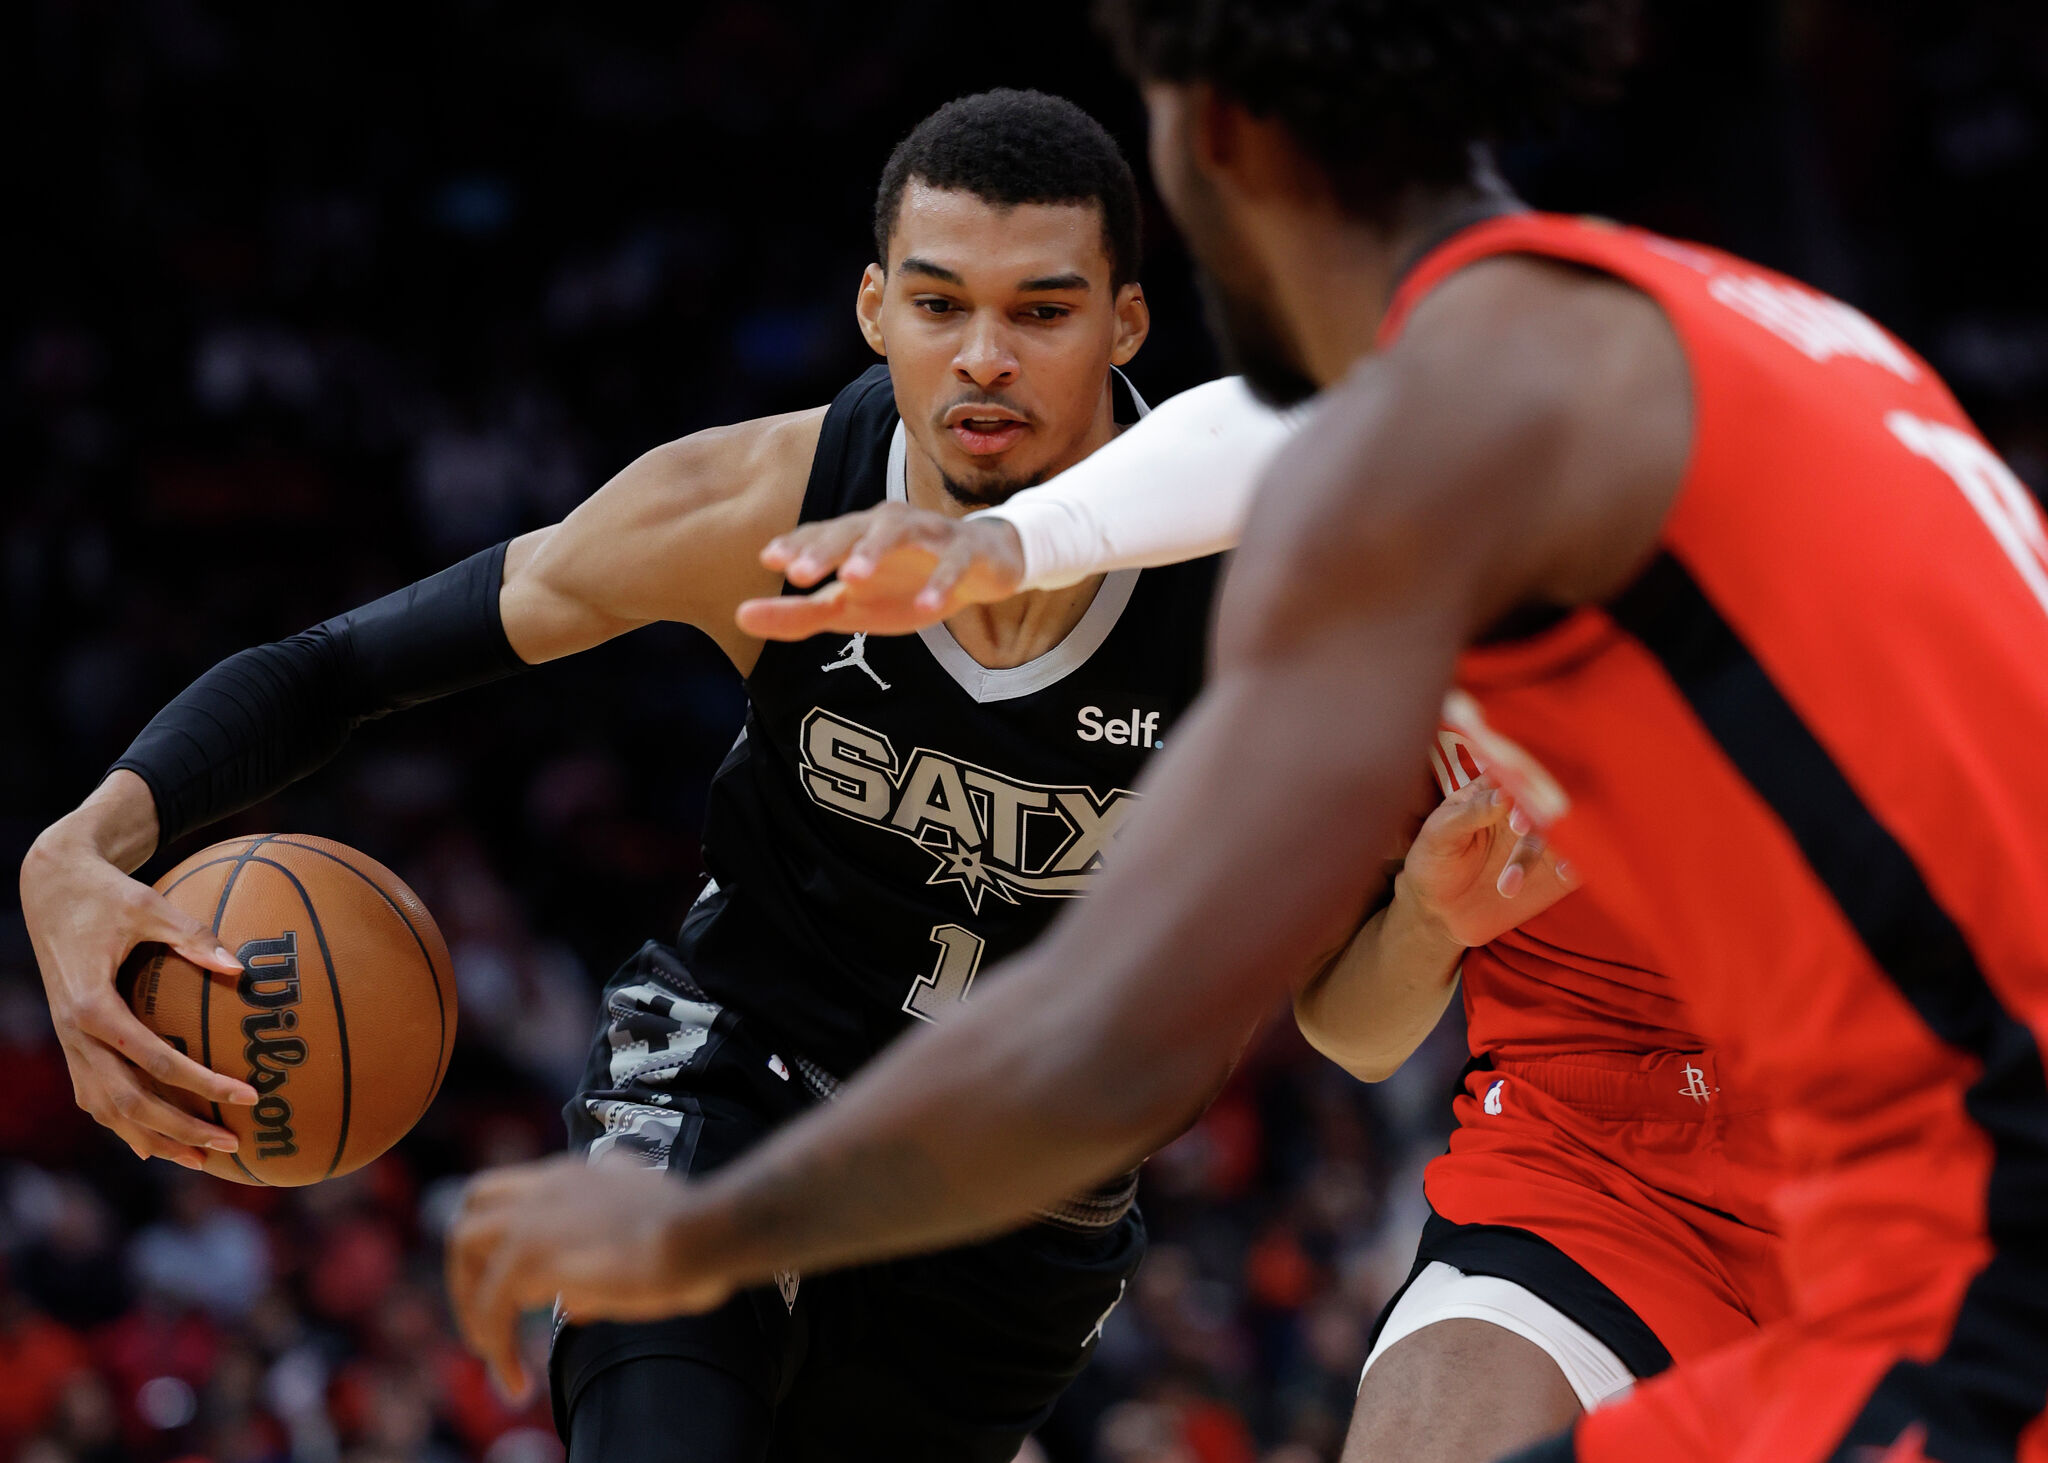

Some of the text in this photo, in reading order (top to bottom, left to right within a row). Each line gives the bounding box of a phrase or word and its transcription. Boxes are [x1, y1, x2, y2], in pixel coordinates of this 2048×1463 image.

[800, 705, 1146, 878] SATX
[236, 930, 309, 1161] Wilson
[901, 923, 985, 1024] 1
